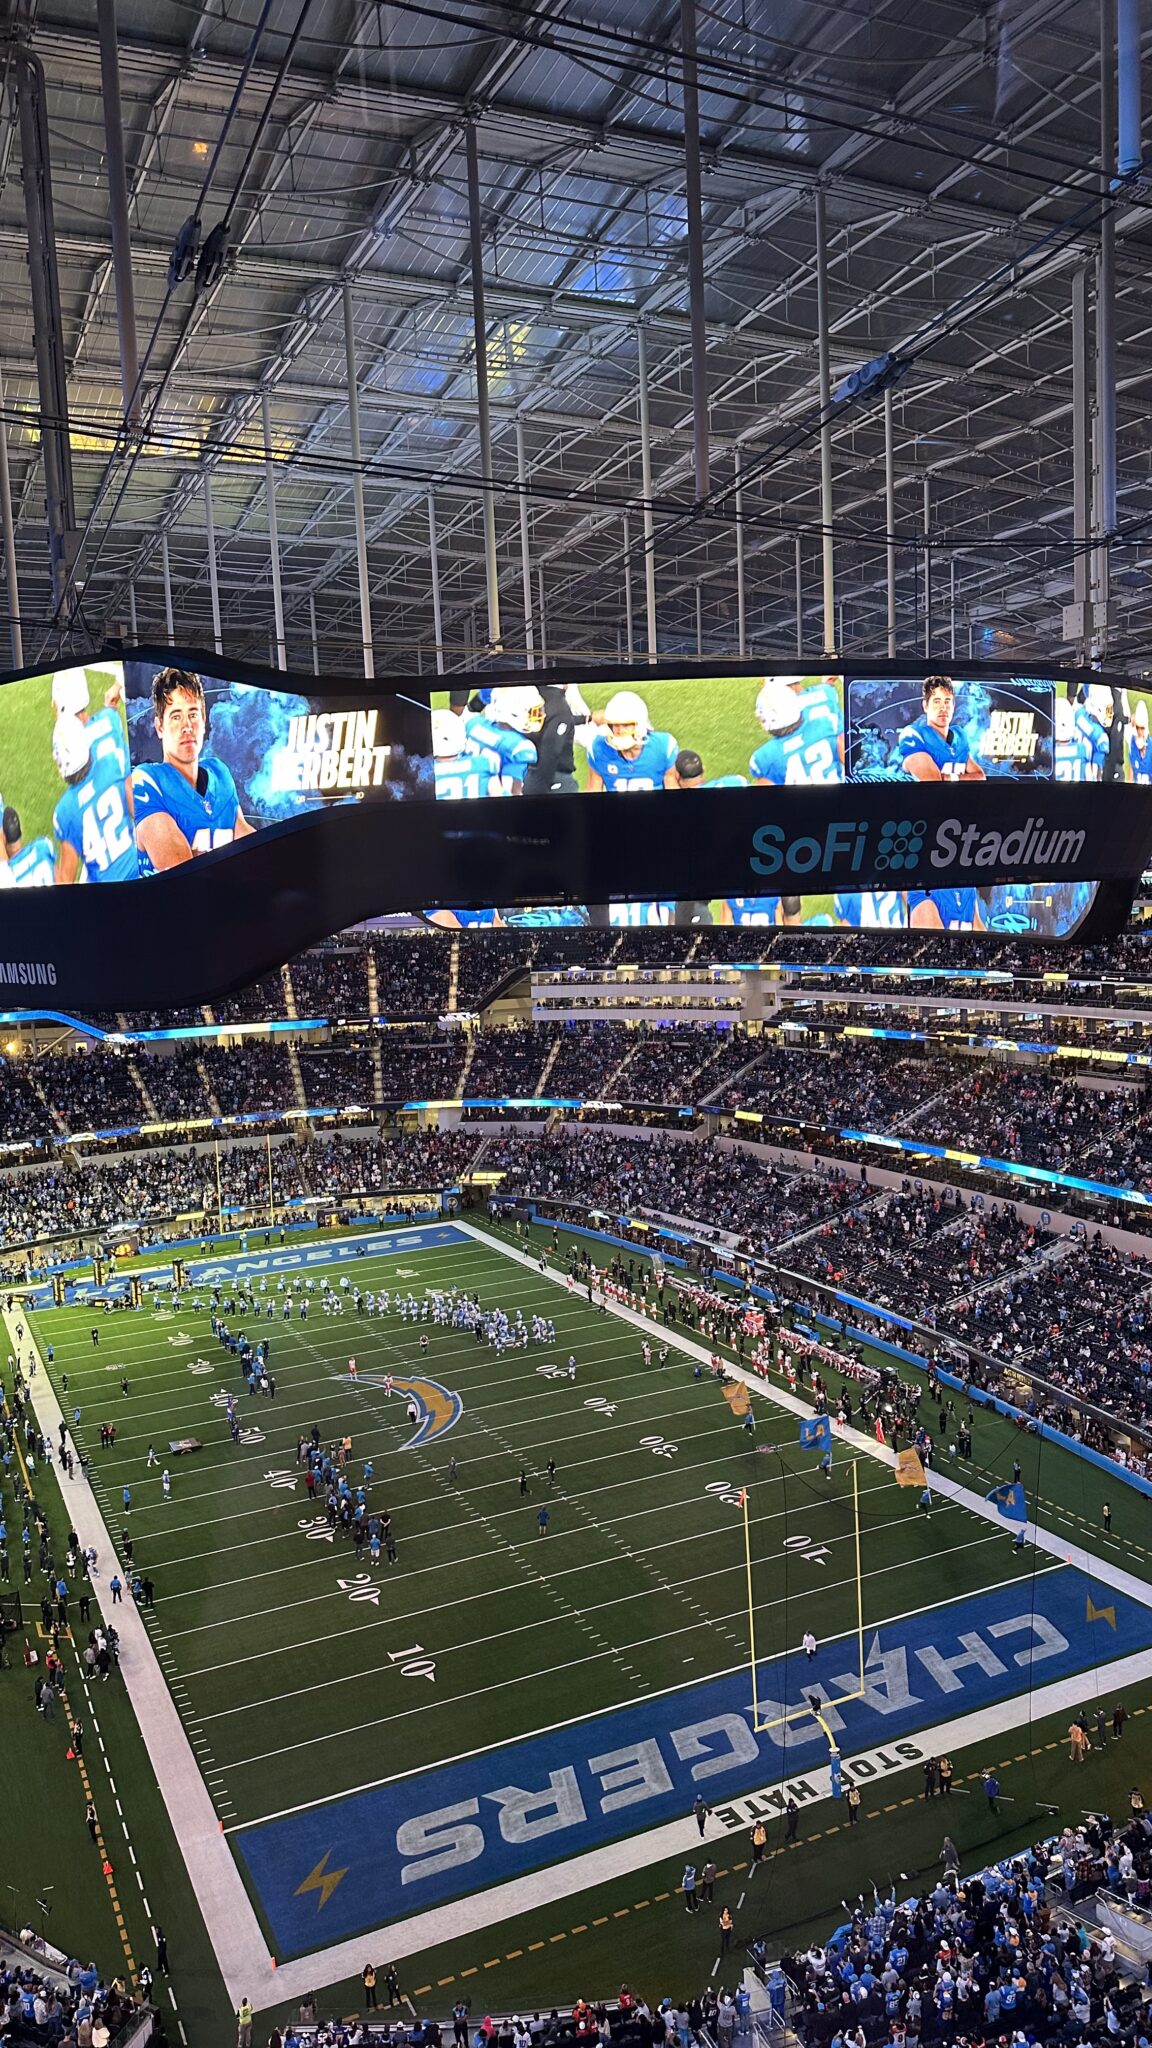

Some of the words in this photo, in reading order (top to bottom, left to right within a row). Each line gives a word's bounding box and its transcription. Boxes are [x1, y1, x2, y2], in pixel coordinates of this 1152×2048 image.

[284, 710, 378, 752] JUSTIN
[82, 784, 133, 873] 42
[750, 821, 870, 875] SoFi
[930, 817, 1087, 869] Stadium
[194, 1236, 423, 1285] ANGELES
[536, 1364, 568, 1380] 50
[583, 1397, 619, 1414] 40
[804, 1422, 826, 1441] LA
[639, 1436, 679, 1456] 30
[263, 1469, 299, 1489] 40
[298, 1516, 336, 1541] 30
[783, 1535, 833, 1561] 10
[336, 1573, 381, 1603] 20
[387, 1643, 437, 1677] 10
[396, 1613, 1070, 1886] CHARGERS
[714, 1780, 819, 1829] HATE
[317, 2032, 328, 2044] 52
